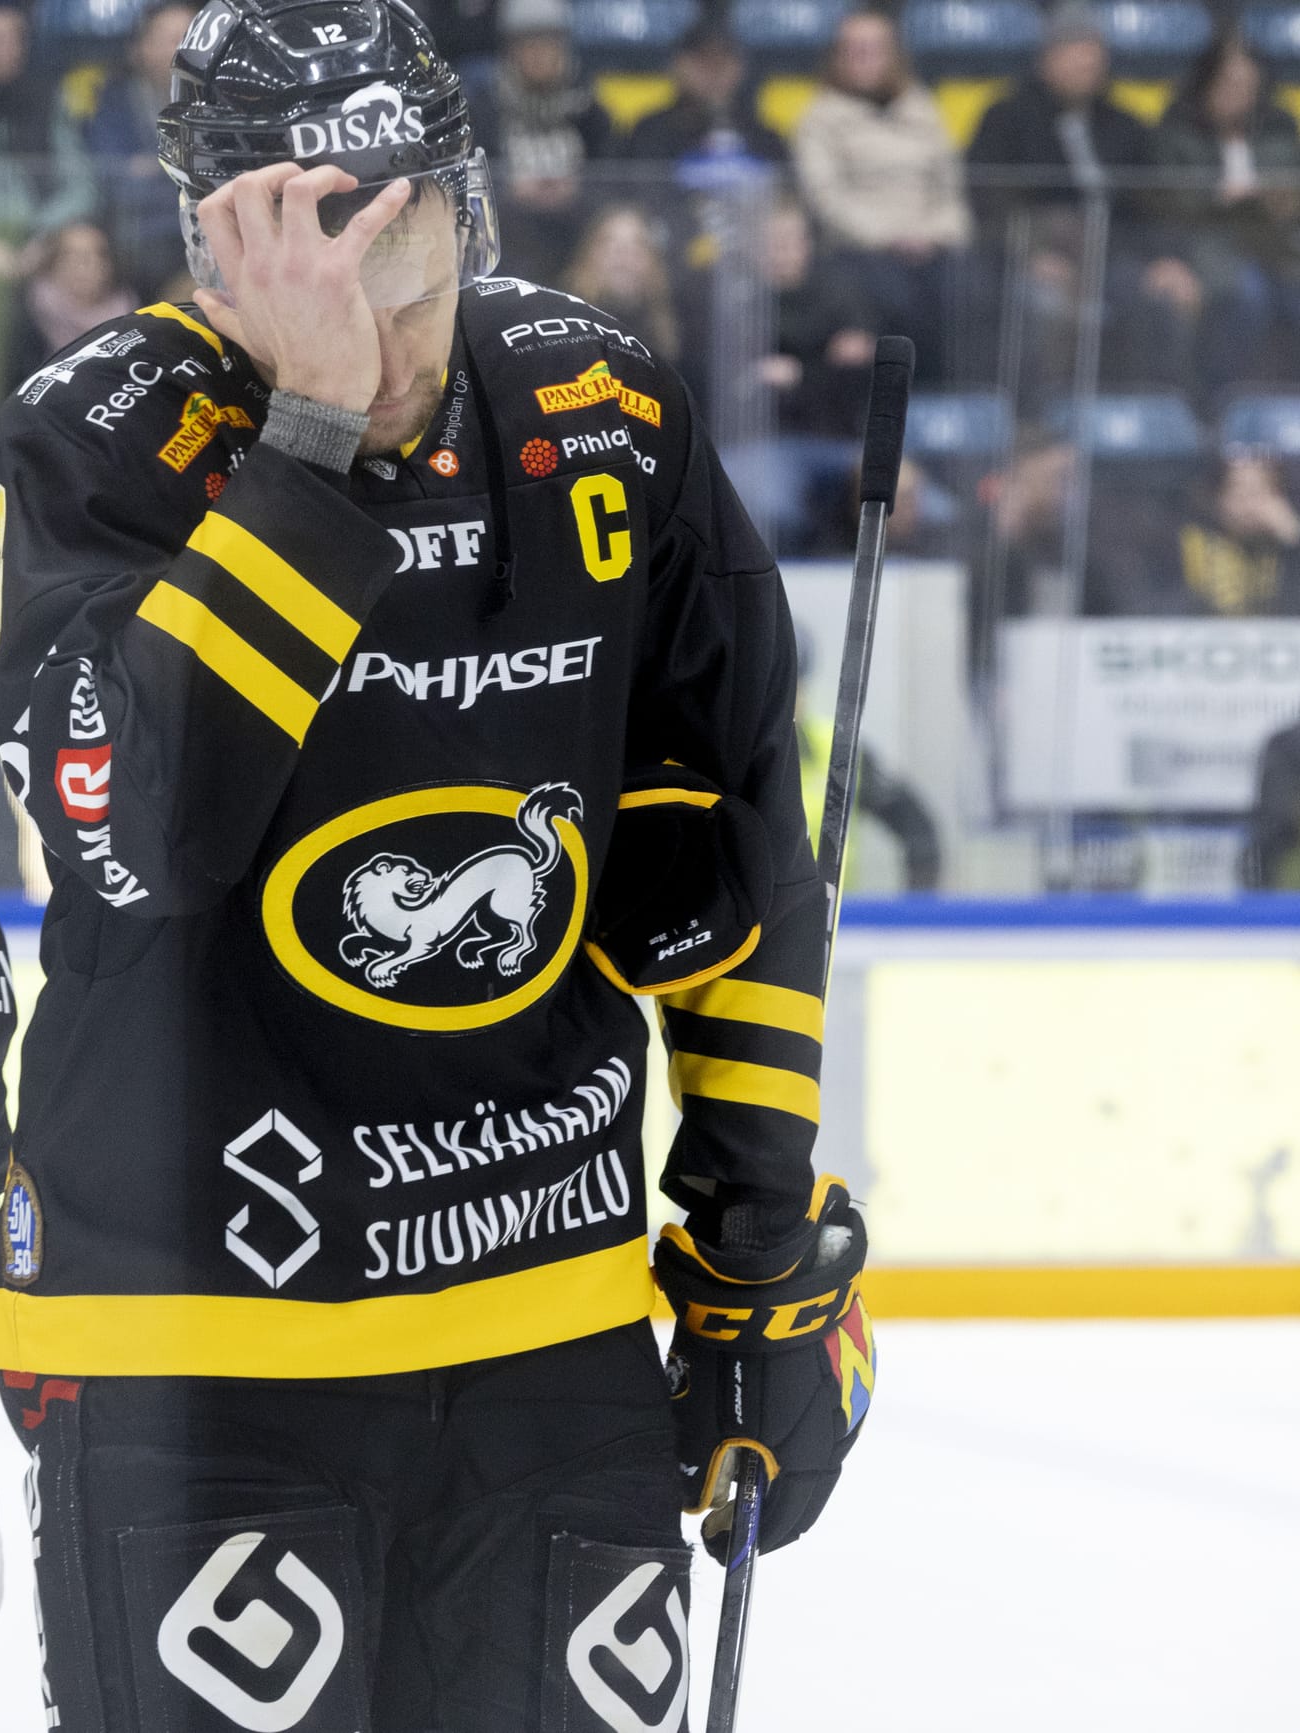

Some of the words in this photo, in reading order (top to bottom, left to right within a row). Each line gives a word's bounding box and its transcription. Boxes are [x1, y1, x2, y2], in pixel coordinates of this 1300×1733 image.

[312, 23, 347, 46] 12
[291, 104, 425, 160] DISAS
[439, 394, 464, 448] Pohjolan
[454, 370, 469, 393] OP
[569, 473, 632, 583] C
[658, 930, 713, 961] CCM
